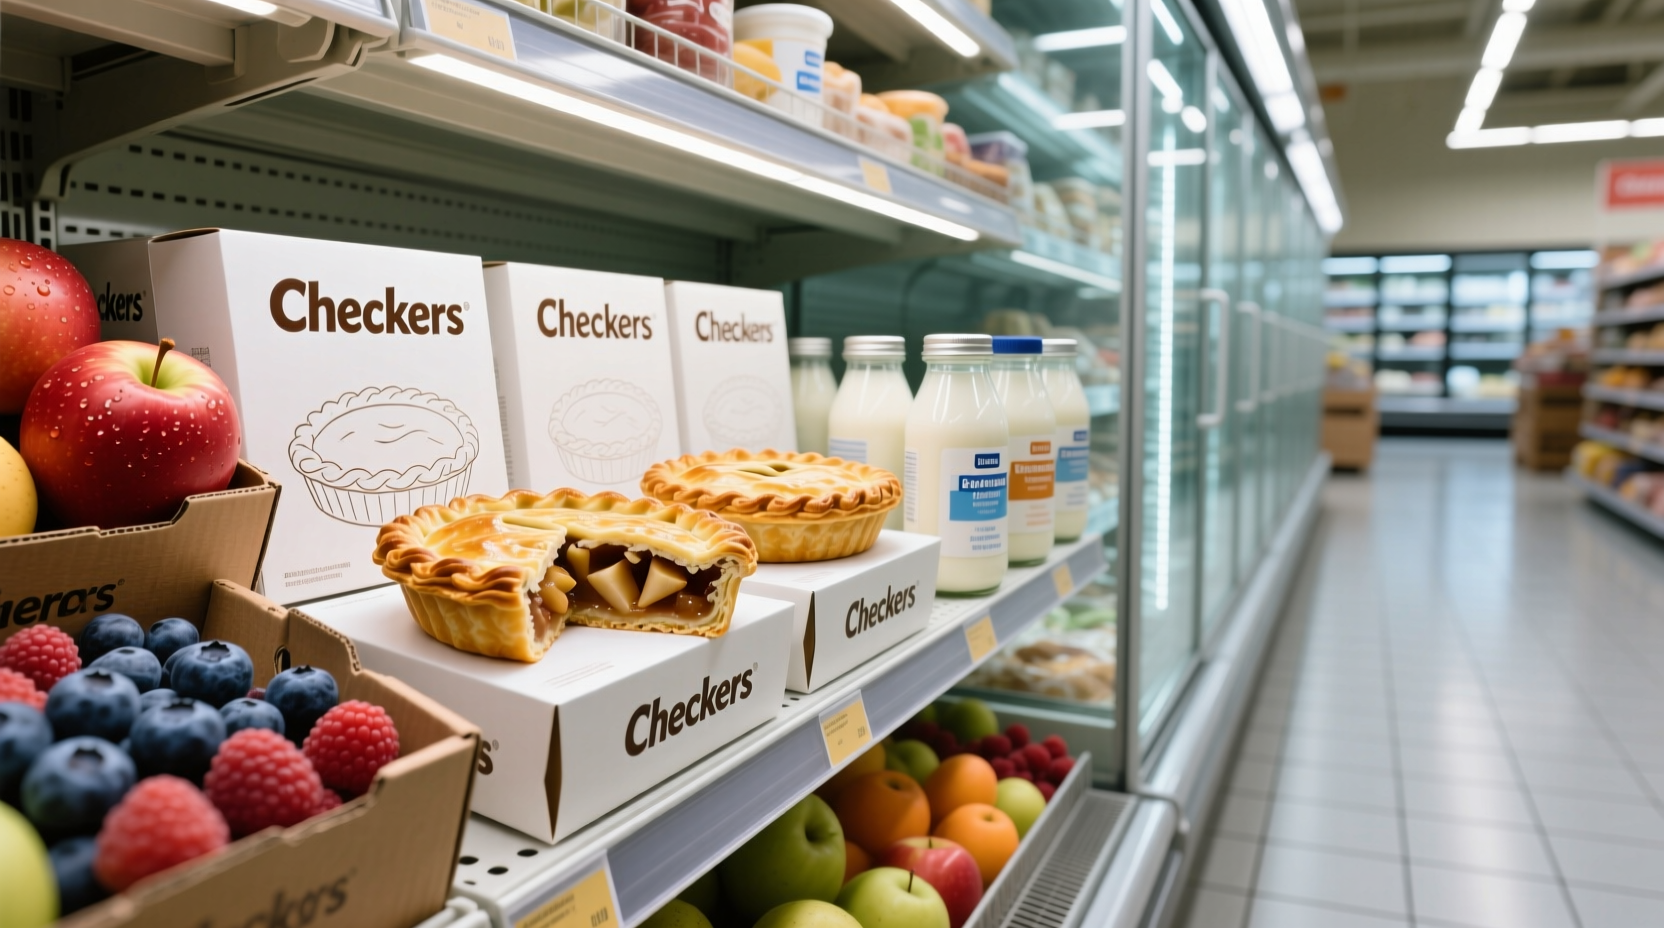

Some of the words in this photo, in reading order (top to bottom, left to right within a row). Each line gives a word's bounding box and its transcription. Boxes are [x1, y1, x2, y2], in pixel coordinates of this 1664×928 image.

[97, 282, 143, 322] ckers
[269, 278, 464, 336] Checkers
[537, 298, 652, 340] Checkers
[695, 310, 773, 342] Checkers
[845, 585, 916, 639] Checkers
[625, 668, 753, 757] Checkers
